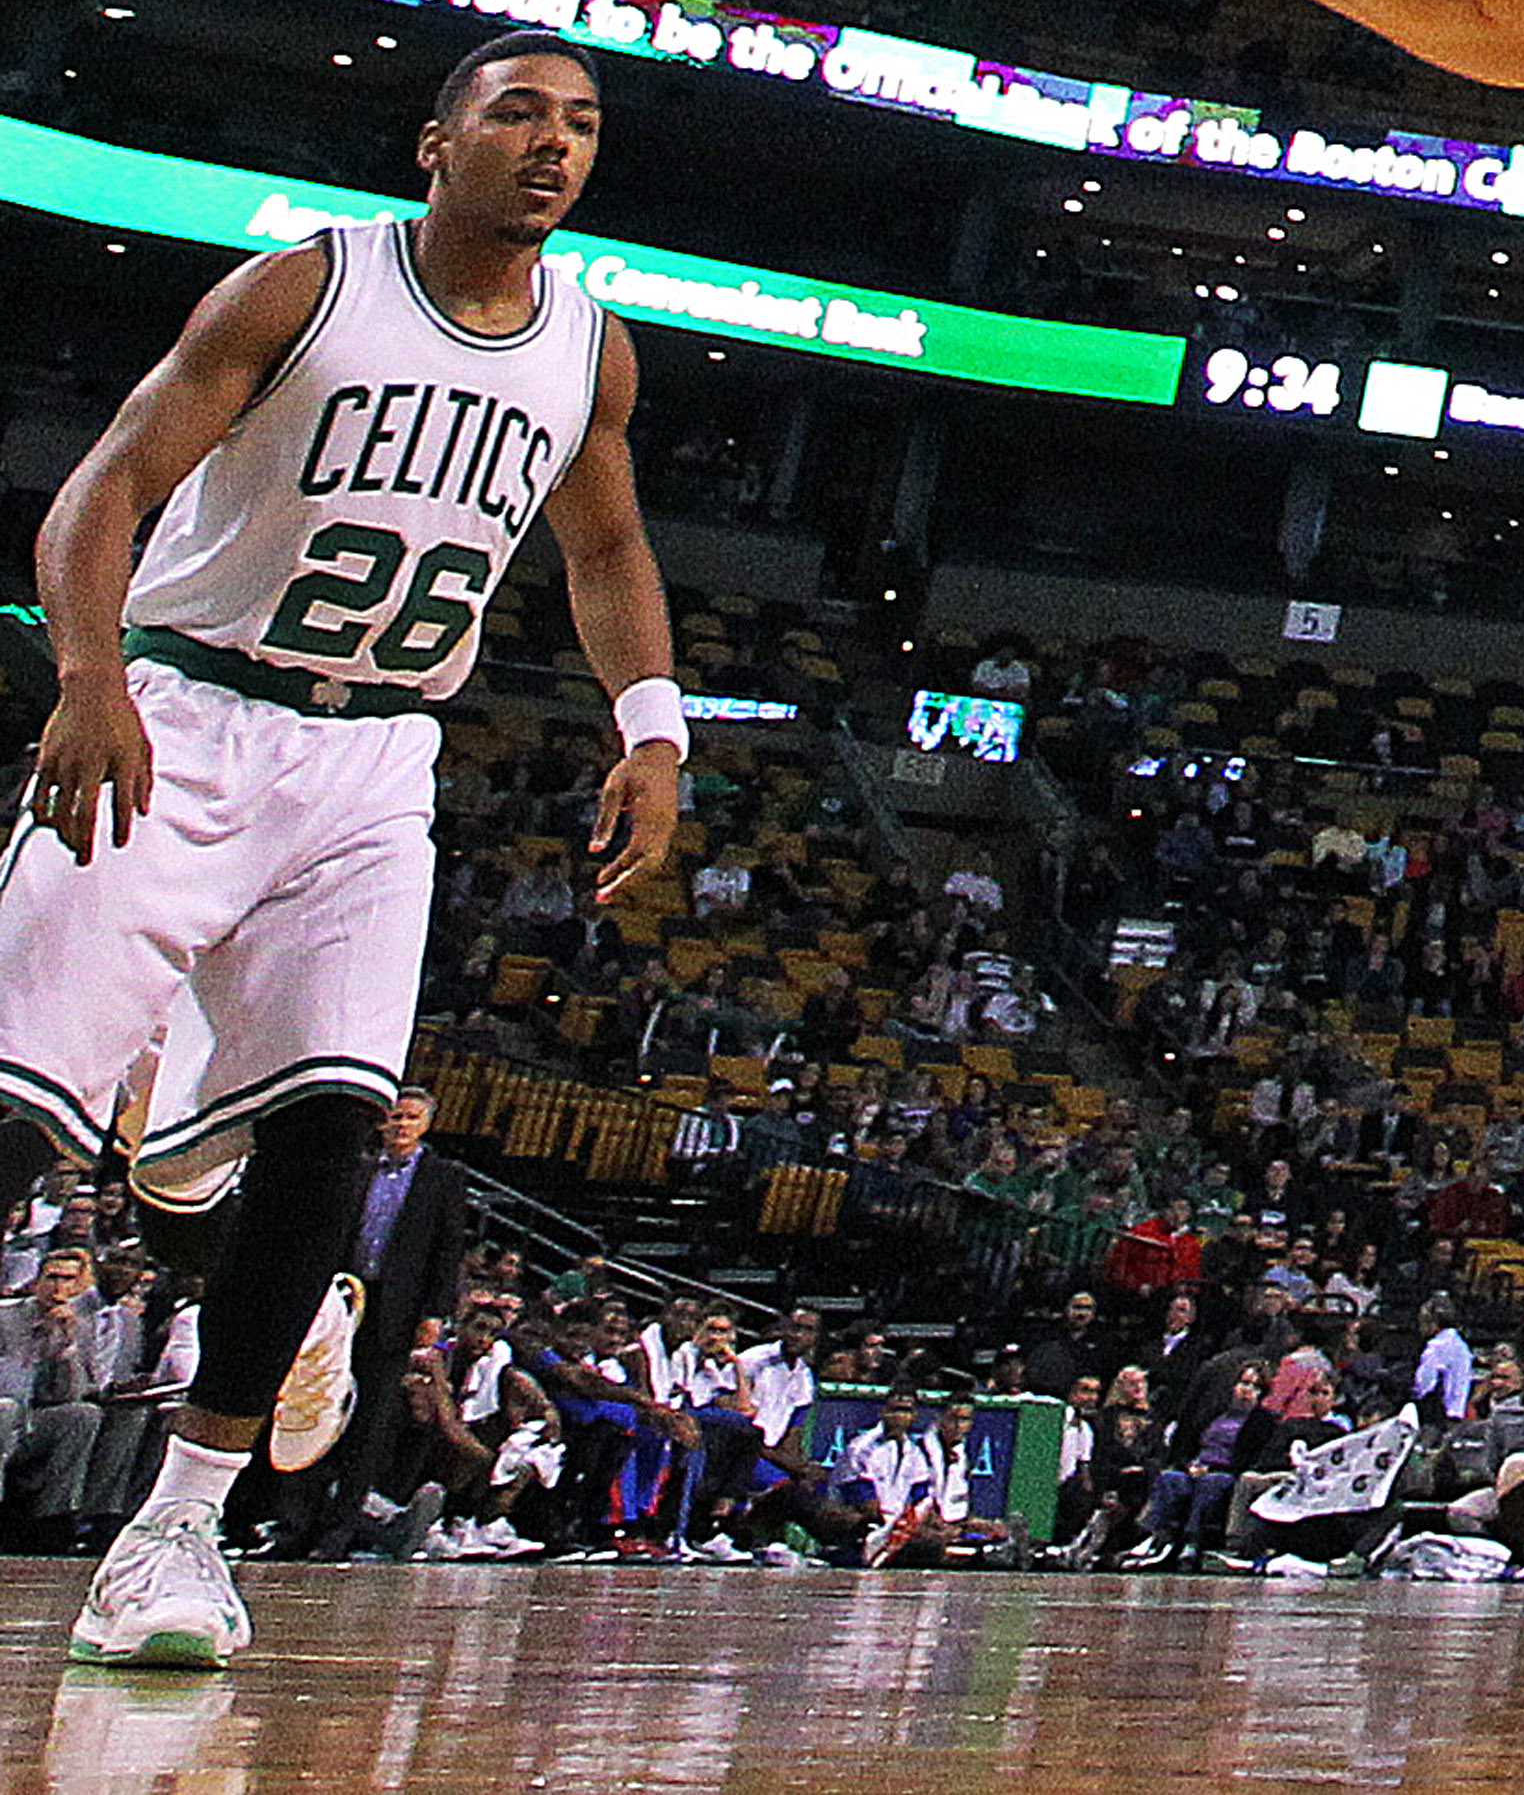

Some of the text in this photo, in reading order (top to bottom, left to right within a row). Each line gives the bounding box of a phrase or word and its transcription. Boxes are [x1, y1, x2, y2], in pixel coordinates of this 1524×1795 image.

[652, 1, 723, 61] be
[729, 24, 817, 80] the
[1128, 110, 1192, 153] of
[1196, 116, 1281, 169] the
[1287, 130, 1456, 196] Boston
[584, 255, 823, 339] Convenient
[822, 298, 928, 357] Bank
[1205, 347, 1342, 416] 9:34
[300, 383, 552, 538] CELTICS
[259, 518, 492, 671] 26
